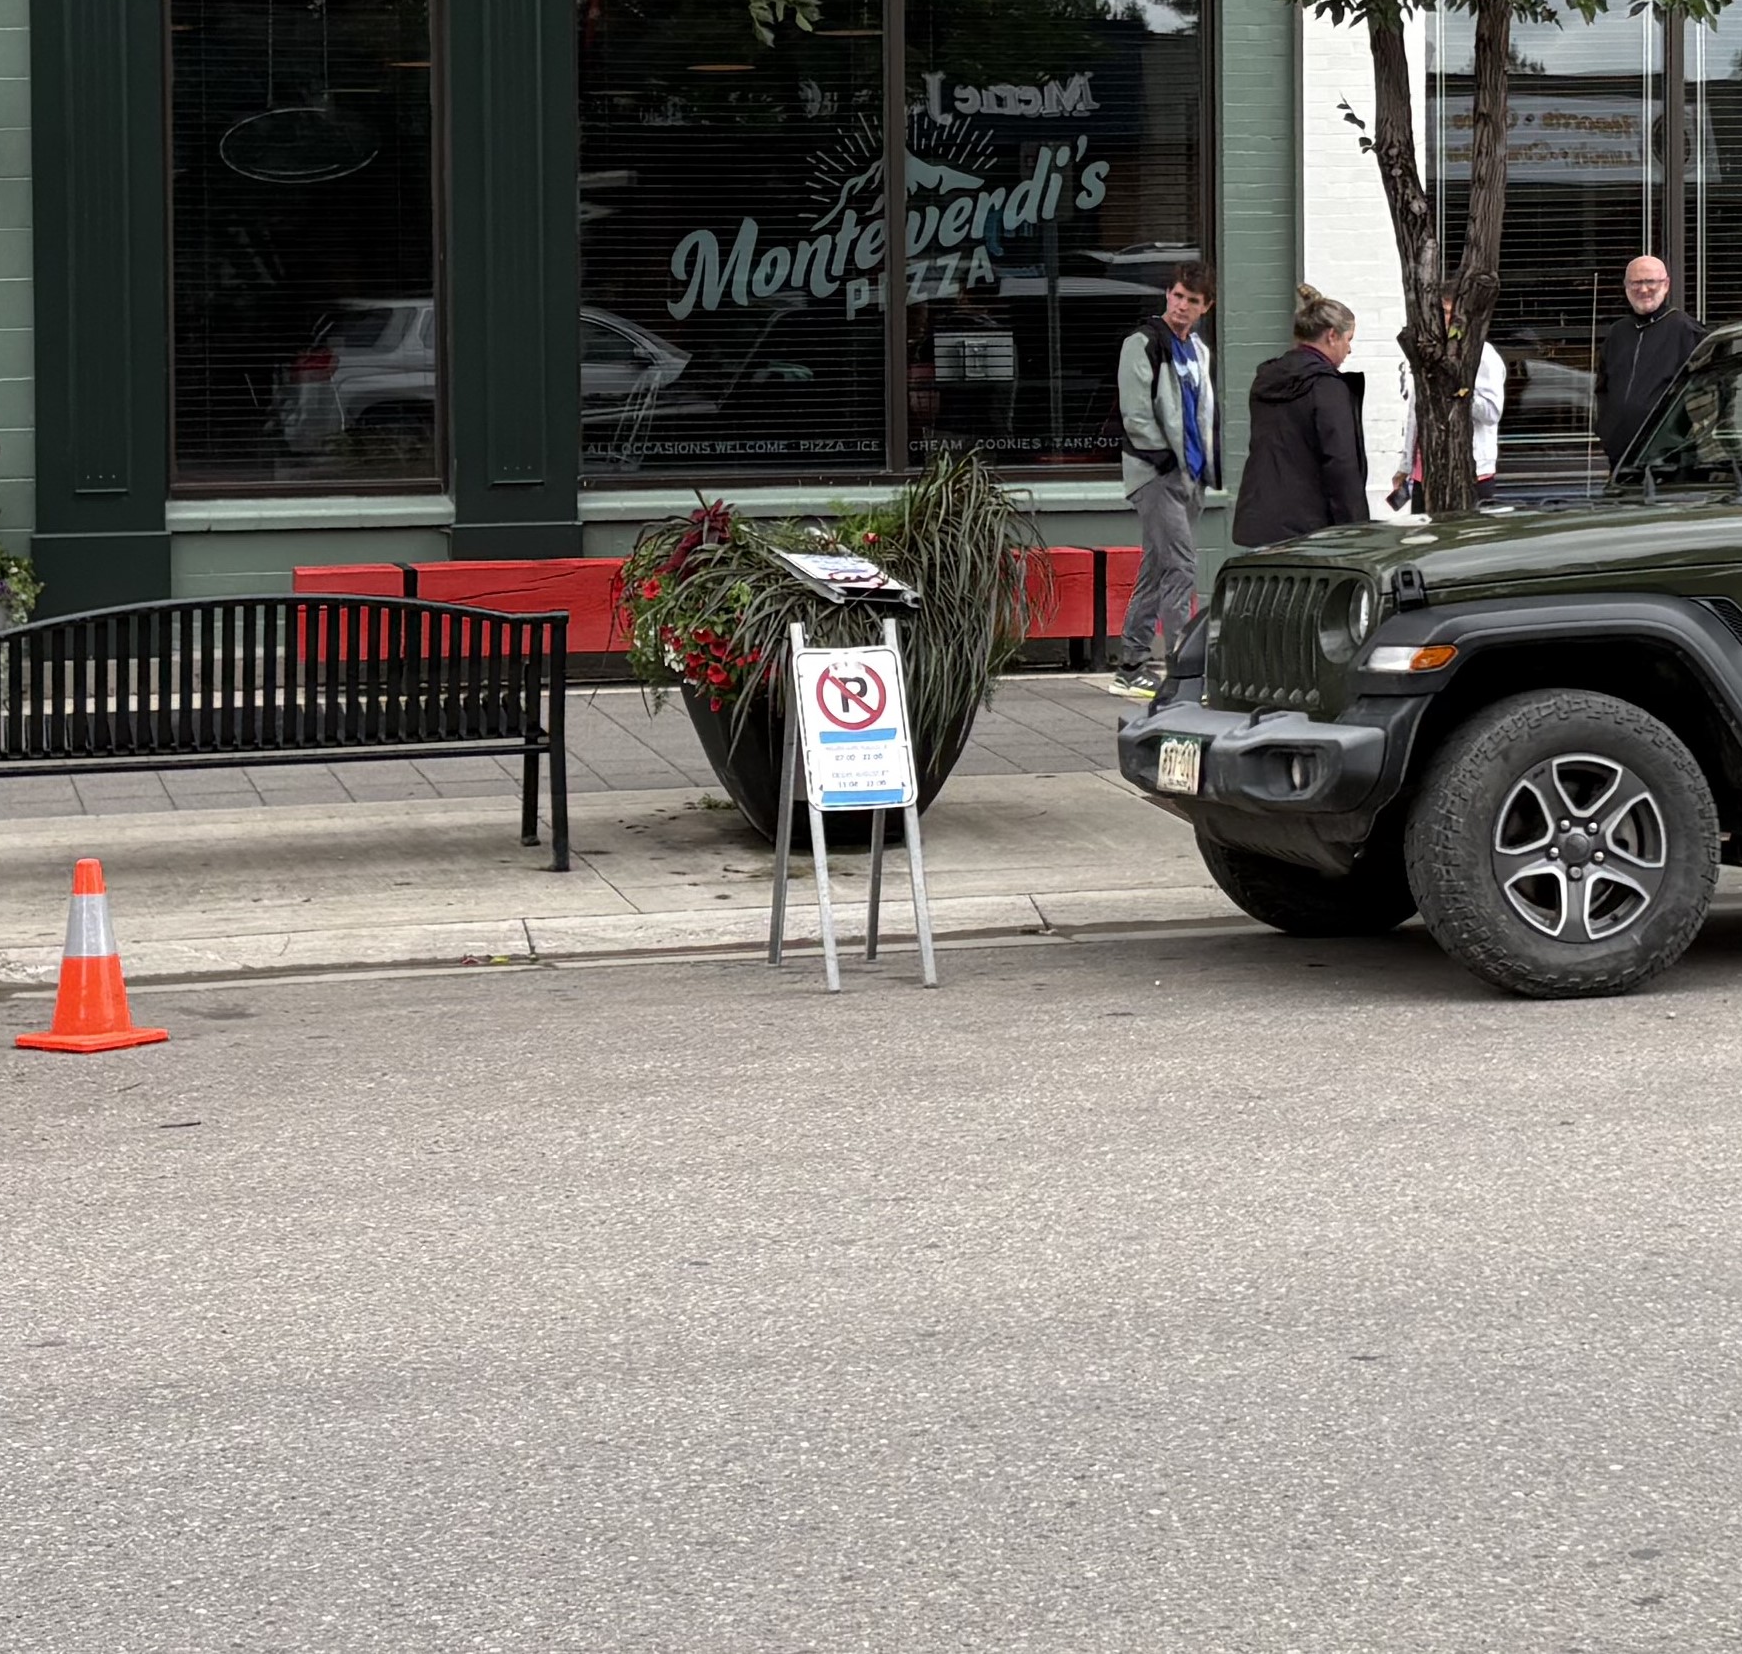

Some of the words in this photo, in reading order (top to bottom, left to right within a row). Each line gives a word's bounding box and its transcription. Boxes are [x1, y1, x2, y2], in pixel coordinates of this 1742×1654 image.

[666, 134, 1111, 321] Monteverdi's
[845, 244, 996, 321] PIZZA
[621, 441, 714, 455] OCCASIONS
[715, 440, 788, 454] WELCOME
[799, 440, 845, 452] PIZZA
[857, 440, 880, 452] ICE
[908, 439, 963, 452] CREAM
[975, 437, 1042, 451] COOKIES
[1053, 436, 1121, 449] TAKE-OU
[838, 676, 868, 713] P
